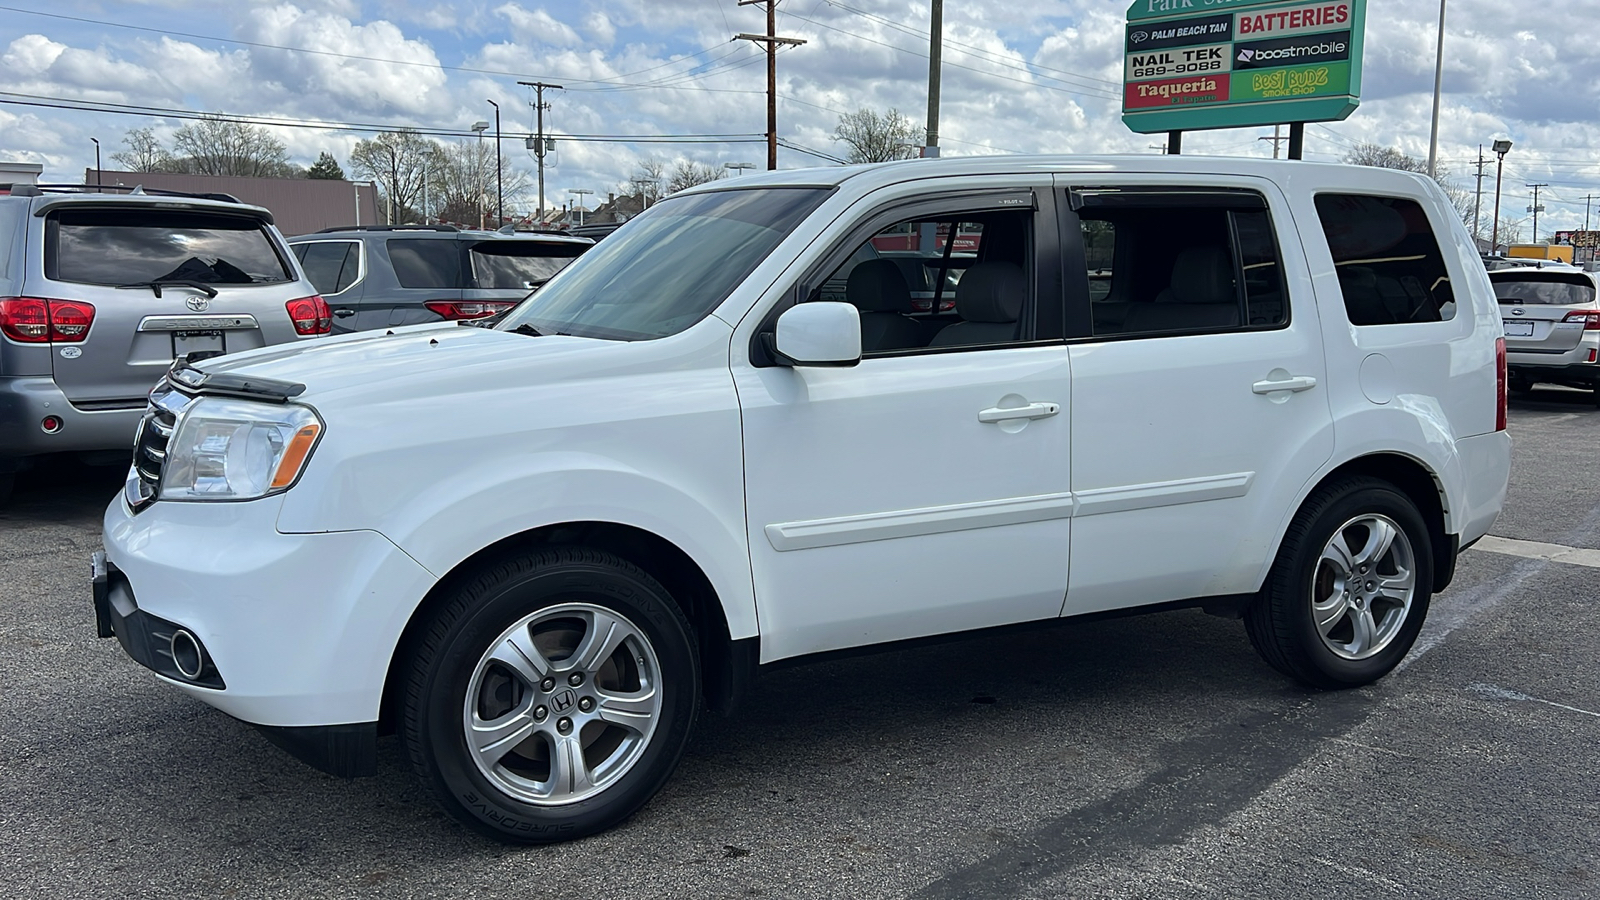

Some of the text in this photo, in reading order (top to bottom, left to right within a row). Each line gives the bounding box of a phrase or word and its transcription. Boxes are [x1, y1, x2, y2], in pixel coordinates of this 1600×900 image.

[1240, 5, 1348, 34] BATTERIES
[1151, 23, 1228, 40] PALM BEACH TAN
[1132, 48, 1222, 67] NAIL TEK
[1255, 42, 1345, 60] boostmobile
[1134, 61, 1221, 77] 689-9088
[1288, 67, 1328, 88] BUDZ
[1262, 86, 1315, 97] SMOKE SHOP
[463, 791, 576, 833] SUREDRIVE
